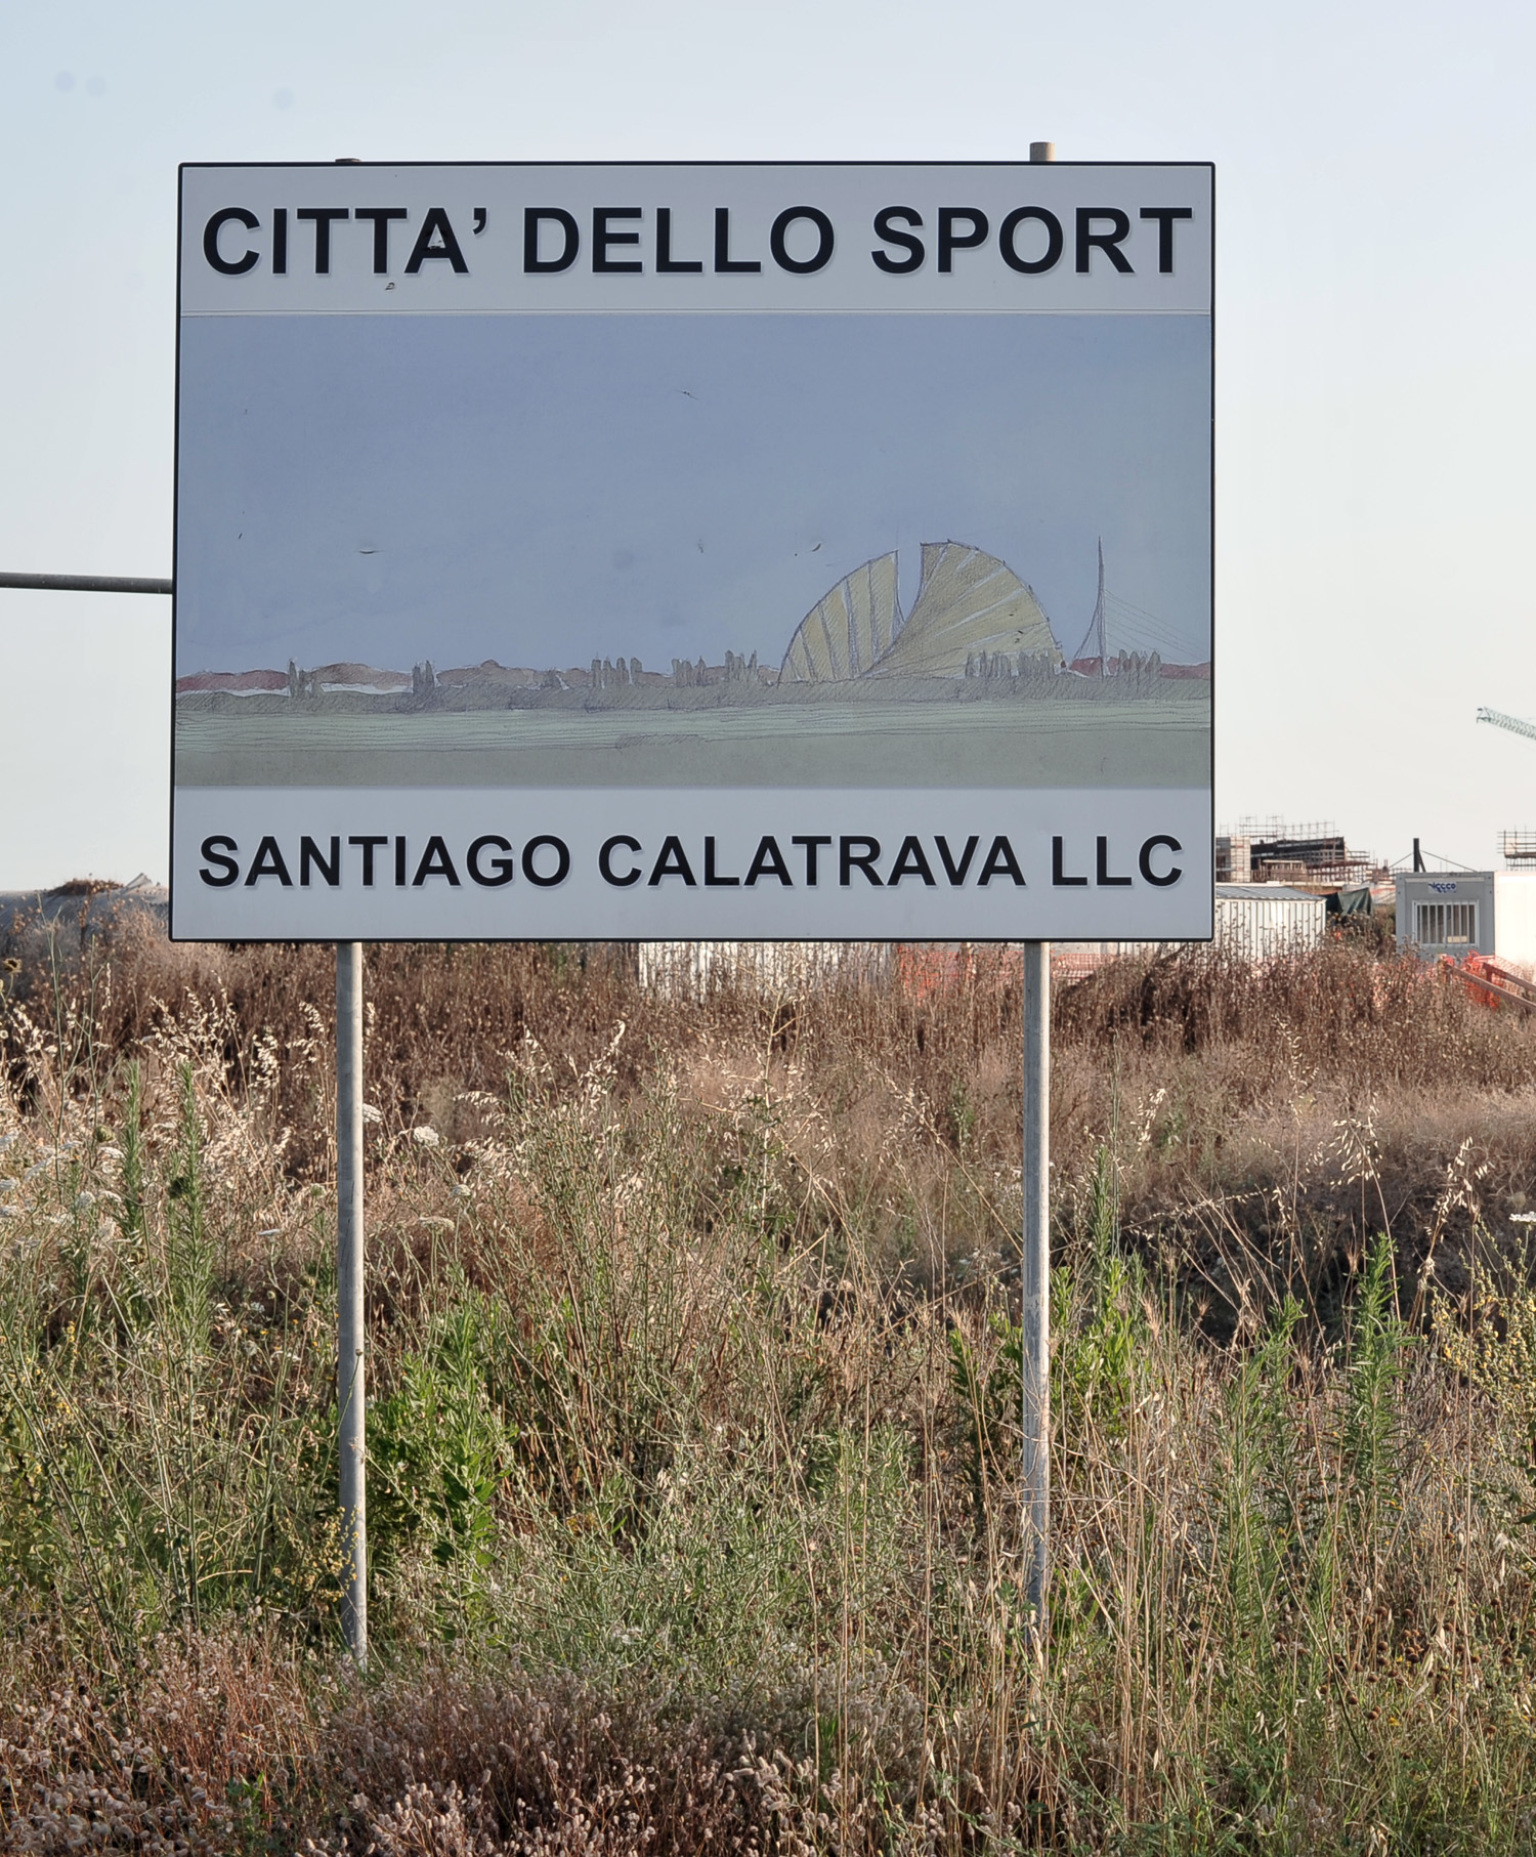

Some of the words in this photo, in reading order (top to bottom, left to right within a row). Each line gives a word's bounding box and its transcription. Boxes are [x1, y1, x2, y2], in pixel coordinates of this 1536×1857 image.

[203, 205, 487, 275] CITTA’
[523, 205, 835, 275] DELLO
[869, 205, 1193, 275] SPORT
[197, 834, 571, 888] SANTIAGO
[597, 834, 1027, 888] CALATRAVA
[1051, 834, 1183, 888] LLC
